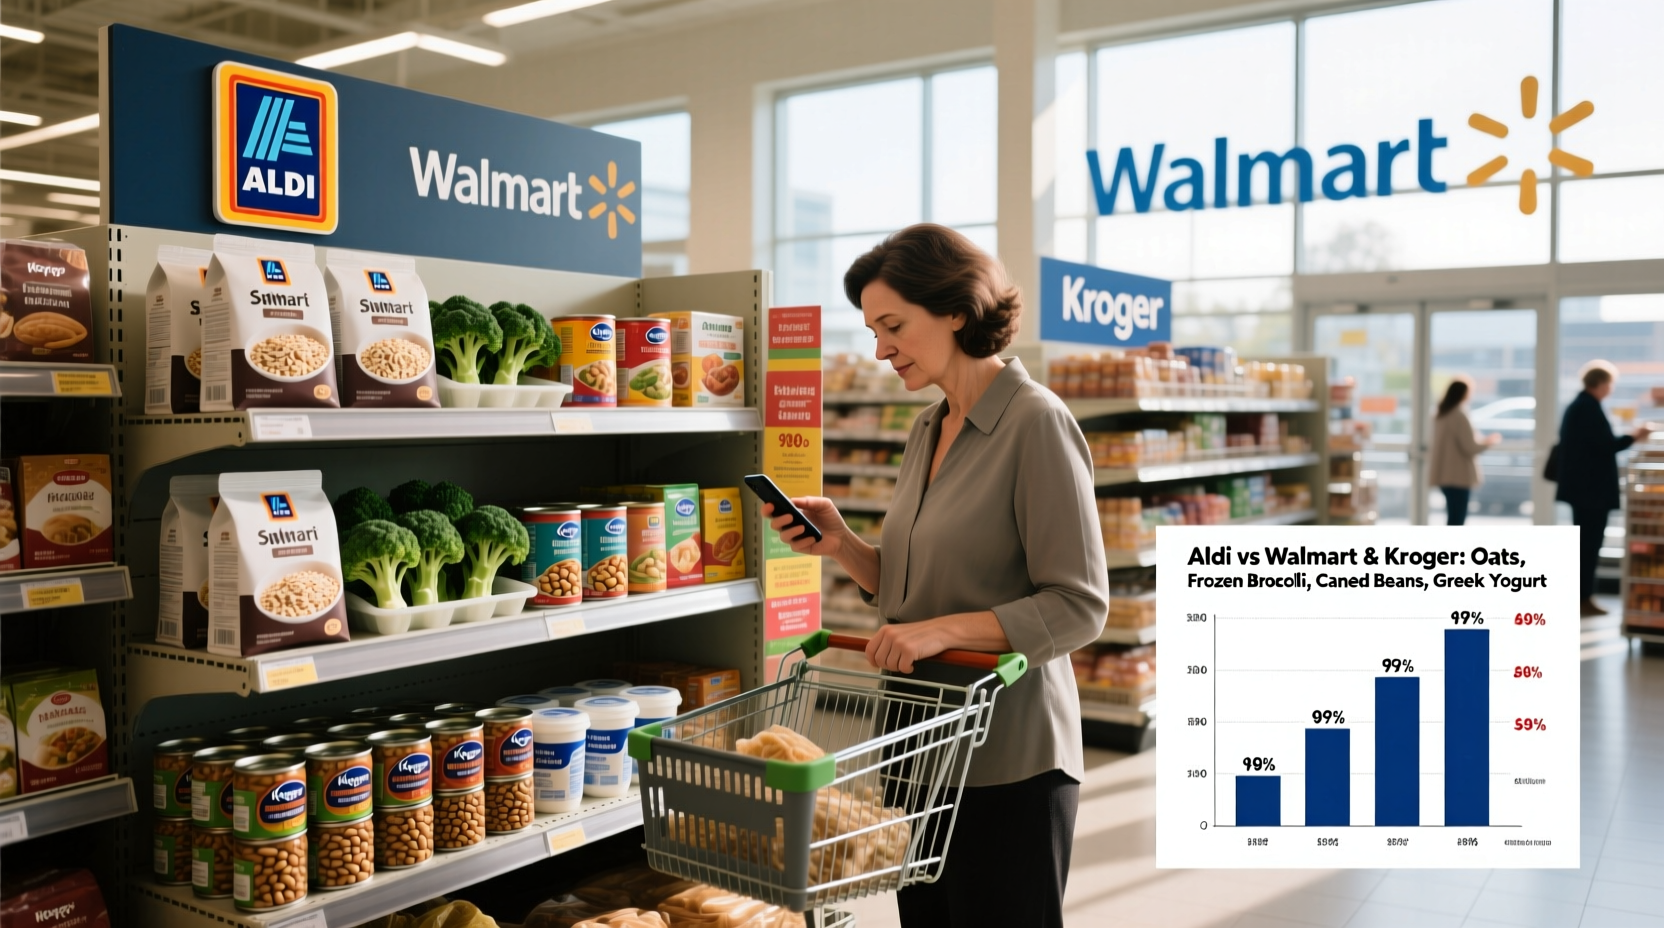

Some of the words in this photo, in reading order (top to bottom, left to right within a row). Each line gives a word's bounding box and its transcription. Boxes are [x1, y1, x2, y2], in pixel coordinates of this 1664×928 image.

[242, 166, 315, 199] ALDI
[409, 146, 582, 221] Walmart
[1086, 118, 1448, 216] Walmart
[1062, 274, 1165, 341] Kroger
